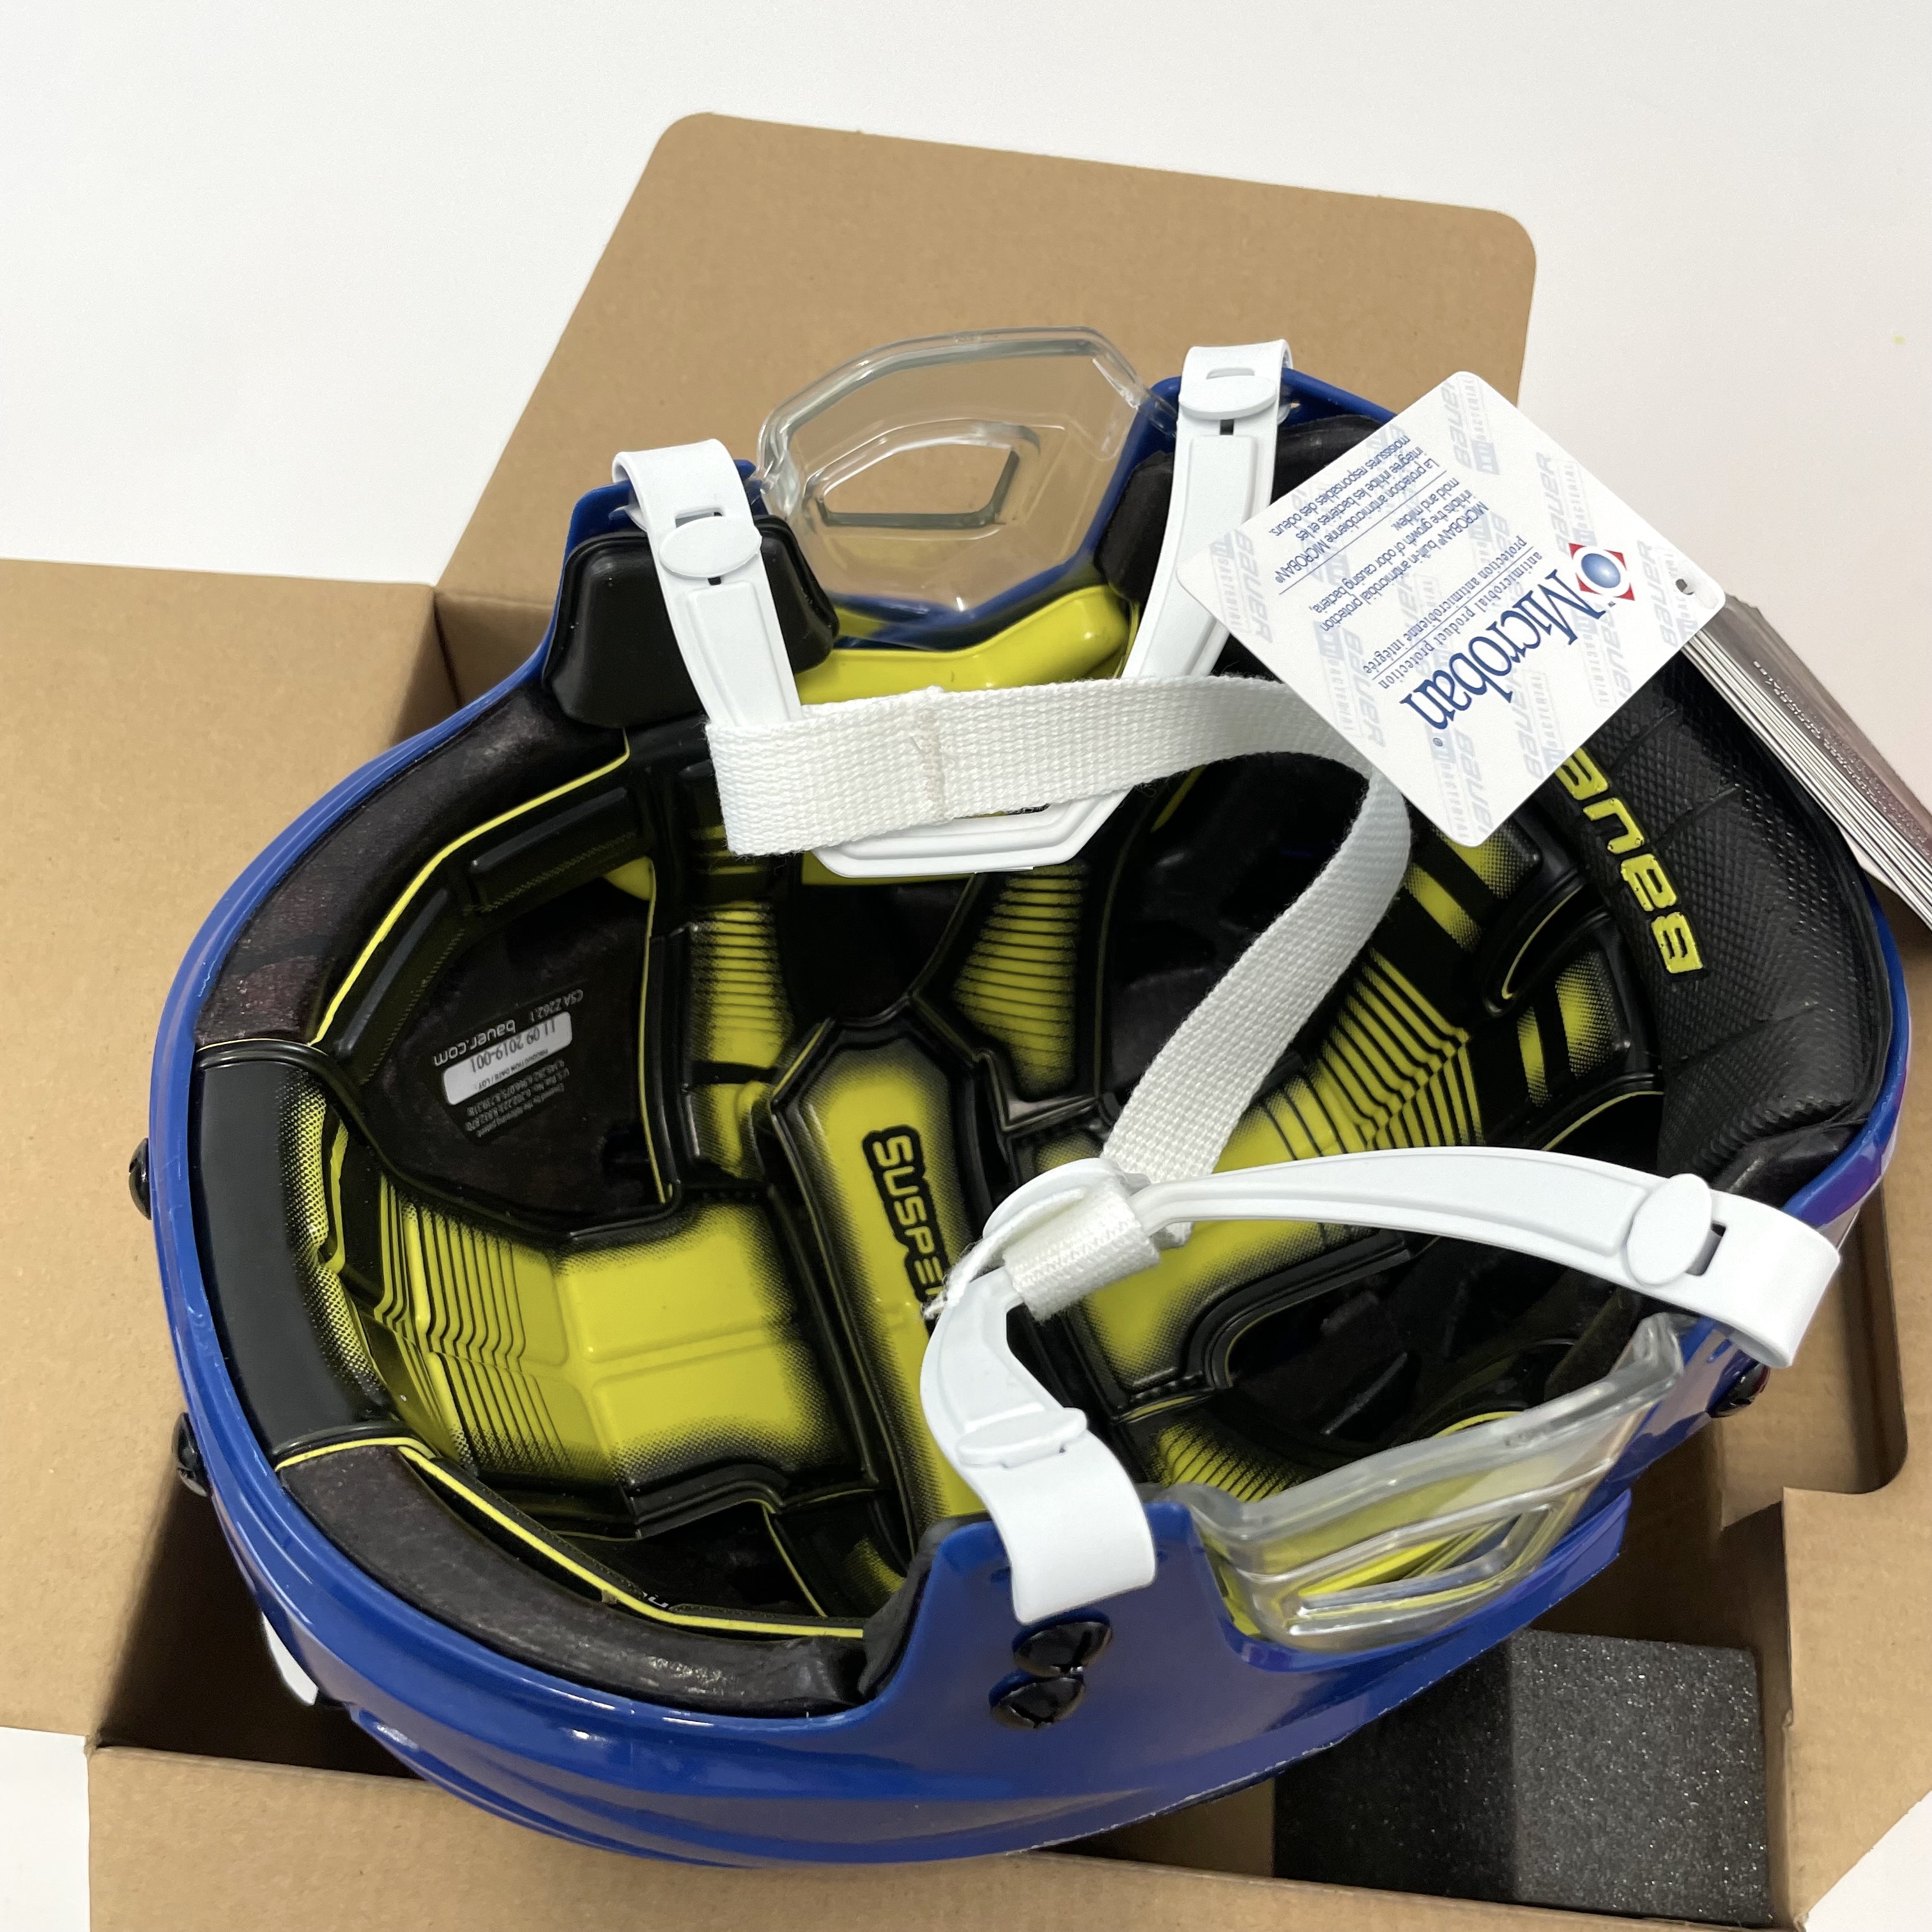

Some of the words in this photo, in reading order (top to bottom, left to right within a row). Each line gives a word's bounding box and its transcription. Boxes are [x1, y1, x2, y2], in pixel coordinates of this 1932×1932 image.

[1386, 461, 1426, 497] protection
[1423, 459, 1439, 468] La
[1315, 466, 1368, 505] responsables
[1353, 488, 1371, 506] les
[1436, 479, 1459, 500] mold
[1300, 503, 1318, 516] des
[1324, 495, 1388, 542] antimicrobienne
[1420, 494, 1439, 511] and
[1430, 511, 1448, 523] the
[1269, 514, 1301, 536] odeurs.
[1296, 529, 1315, 540] les
[1307, 523, 1320, 537] et
[1404, 518, 1432, 546] growth
[1376, 549, 1396, 567] odor
[1395, 542, 1405, 556] of
[1478, 536, 1527, 578] protection
[1342, 564, 1377, 595] causing
[1360, 561, 1411, 604] antimicrobial
[1475, 552, 1542, 612] antimicrobial
[1320, 594, 1363, 631] protection
[1404, 578, 1479, 641] antimicrobienne
[1434, 606, 1475, 645] product
[1363, 640, 1407, 673] intégrée
[1378, 640, 1435, 689] protection
[433, 1020, 516, 1066] bauer.com
[469, 1038, 524, 1073] 2019-001
